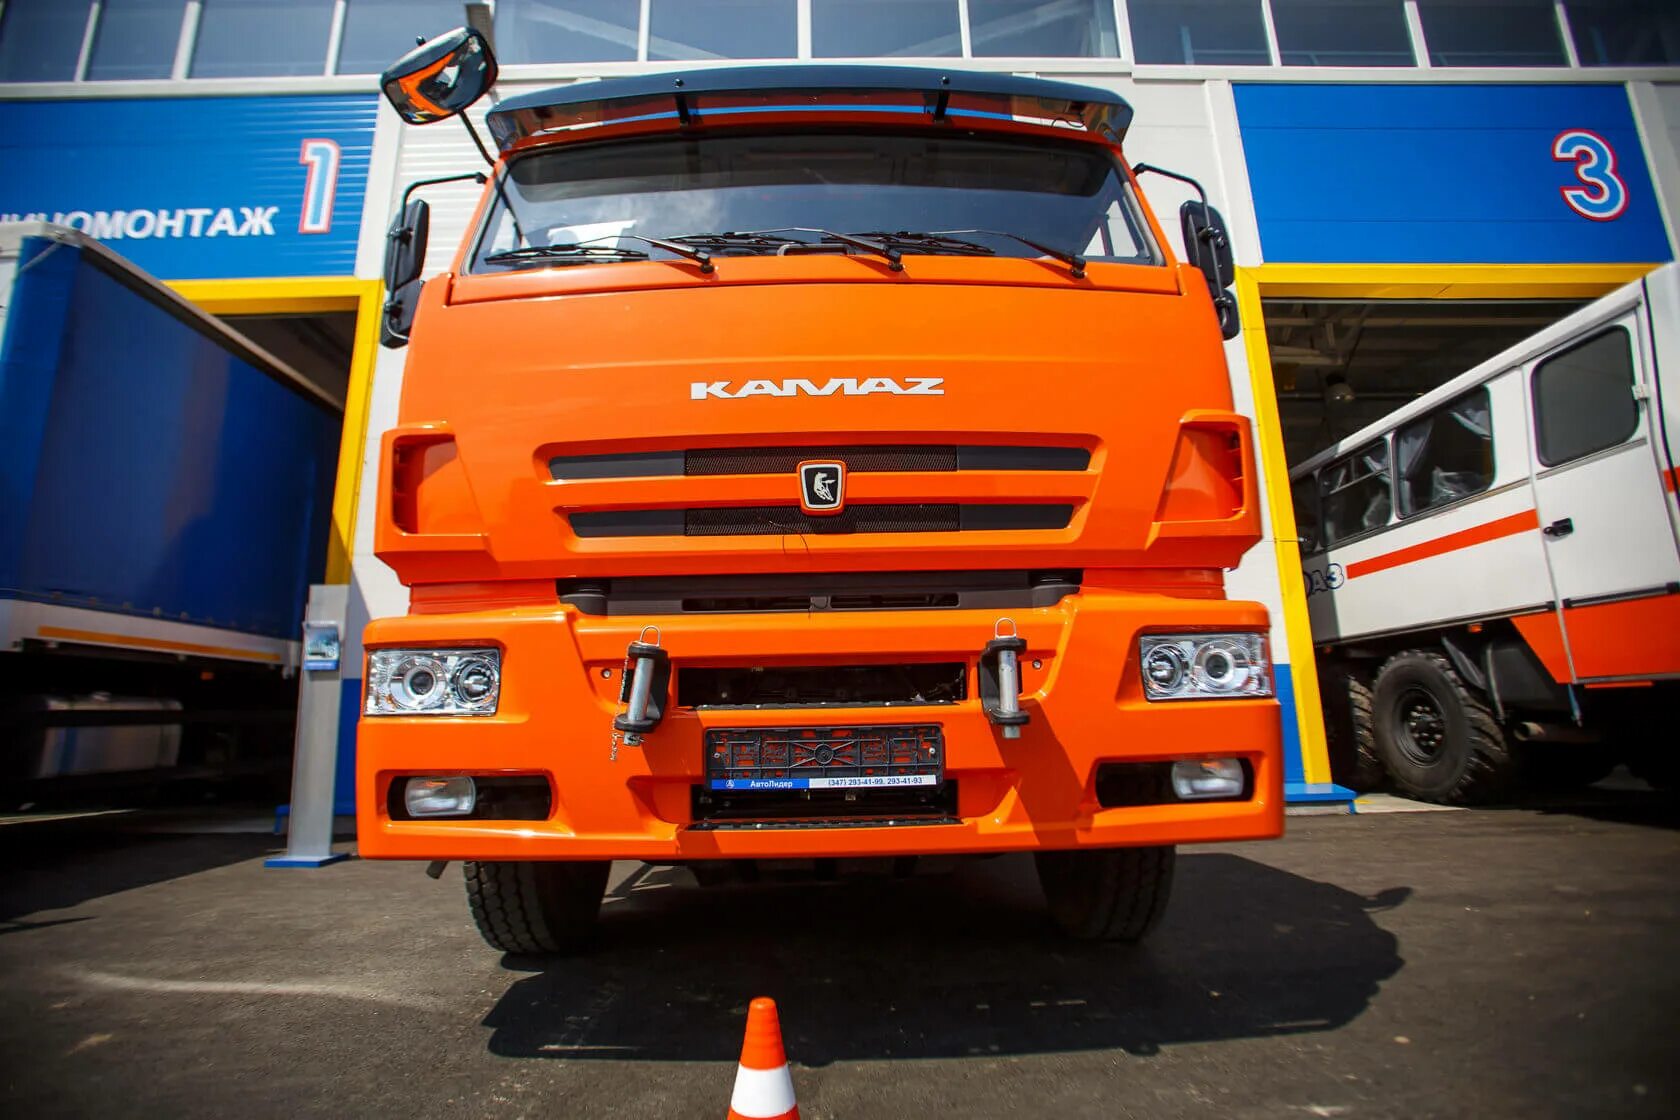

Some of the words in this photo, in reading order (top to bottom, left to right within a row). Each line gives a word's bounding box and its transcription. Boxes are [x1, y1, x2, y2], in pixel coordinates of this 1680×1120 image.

[299, 138, 340, 234] 1
[1551, 128, 1630, 221] 3
[0, 206, 279, 239] ОМОНТАЖ
[690, 377, 945, 400] KAMAZ
[750, 780, 793, 789] АвтоЛидер
[828, 778, 846, 786] (347)
